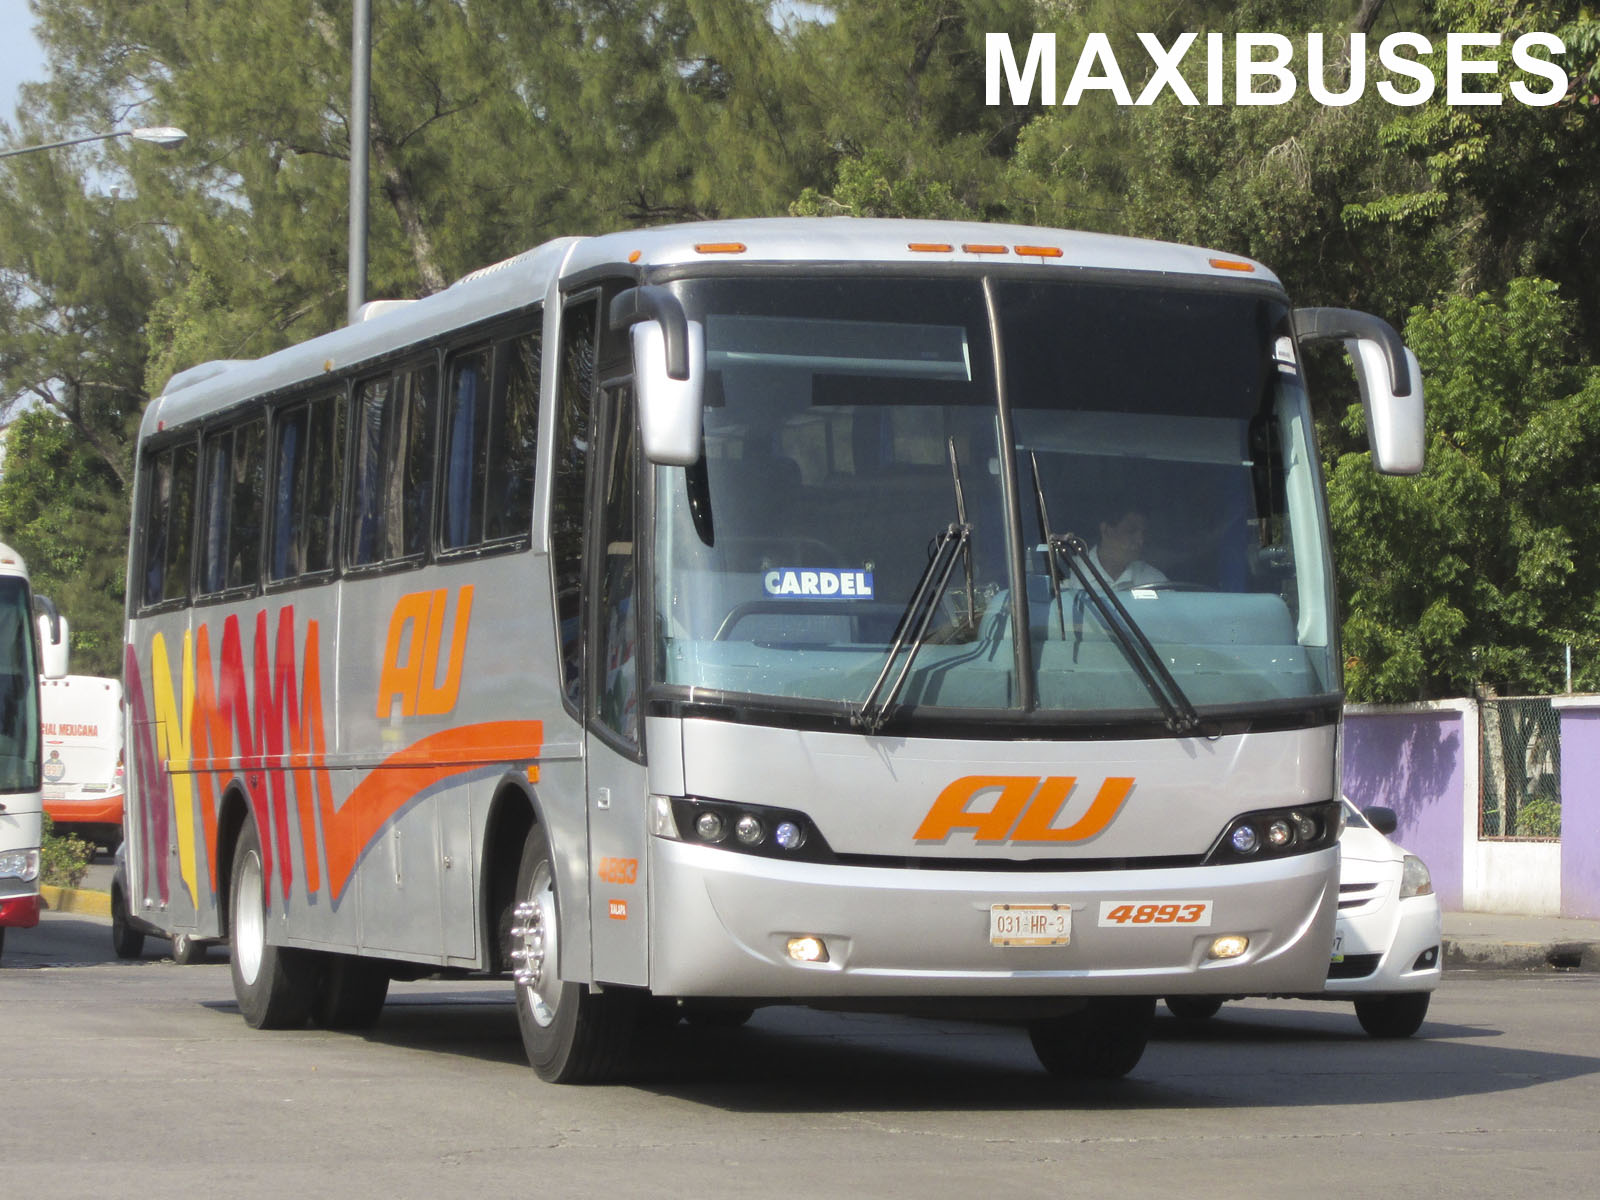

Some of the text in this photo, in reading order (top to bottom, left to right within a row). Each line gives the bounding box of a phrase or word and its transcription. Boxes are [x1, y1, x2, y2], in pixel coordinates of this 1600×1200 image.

[765, 571, 872, 595] CARDEL
[376, 584, 475, 718] AU
[59, 724, 98, 736] MEXICANA
[912, 775, 1136, 846] AU
[598, 857, 638, 885] 4893
[1106, 904, 1206, 924] 4893
